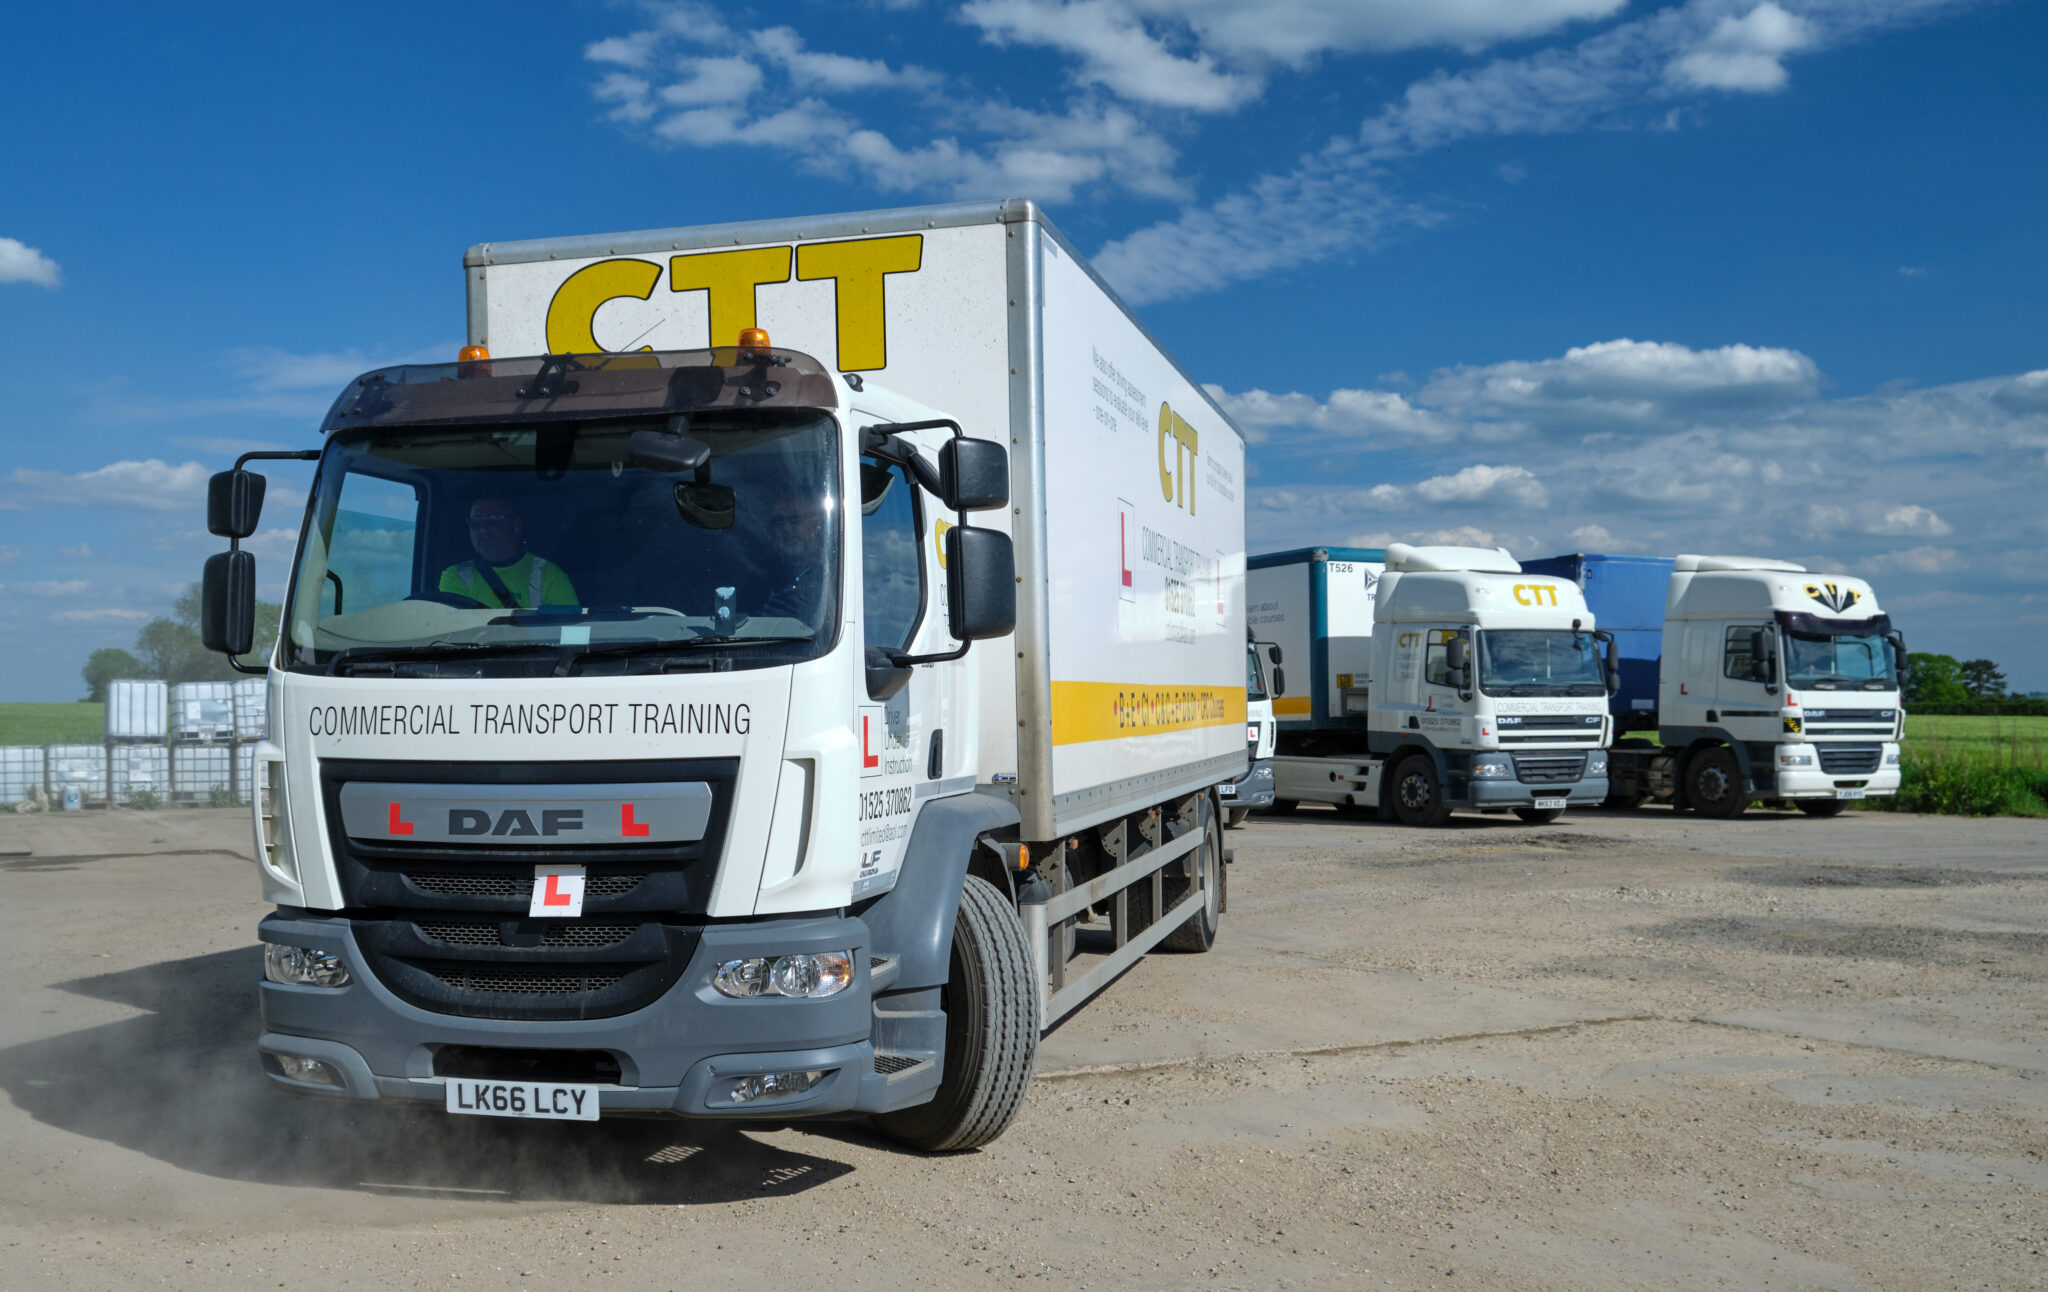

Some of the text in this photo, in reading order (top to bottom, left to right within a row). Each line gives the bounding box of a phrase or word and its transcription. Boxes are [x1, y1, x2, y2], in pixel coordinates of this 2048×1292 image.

[546, 234, 923, 372] CTT
[1158, 401, 1198, 516] CTT
[1121, 512, 1132, 587] L
[1329, 563, 1353, 573] T526
[1513, 584, 1558, 606] CTT
[1803, 581, 1862, 604] CTT
[1399, 633, 1422, 648] CTT
[1680, 683, 1688, 695] L
[1787, 694, 1798, 706] L
[309, 703, 751, 736] COMMERCIAL TRANSPORT TRAINING
[1250, 730, 1255, 738] L
[1482, 728, 1490, 736] L
[863, 716, 879, 768] L
[859, 786, 912, 821] 01525 370862
[389, 803, 413, 835] L
[449, 809, 583, 836] DAF
[621, 803, 649, 836] L
[862, 850, 881, 869] LF
[544, 874, 571, 906] L
[458, 1083, 586, 1115] LK66 LCY
